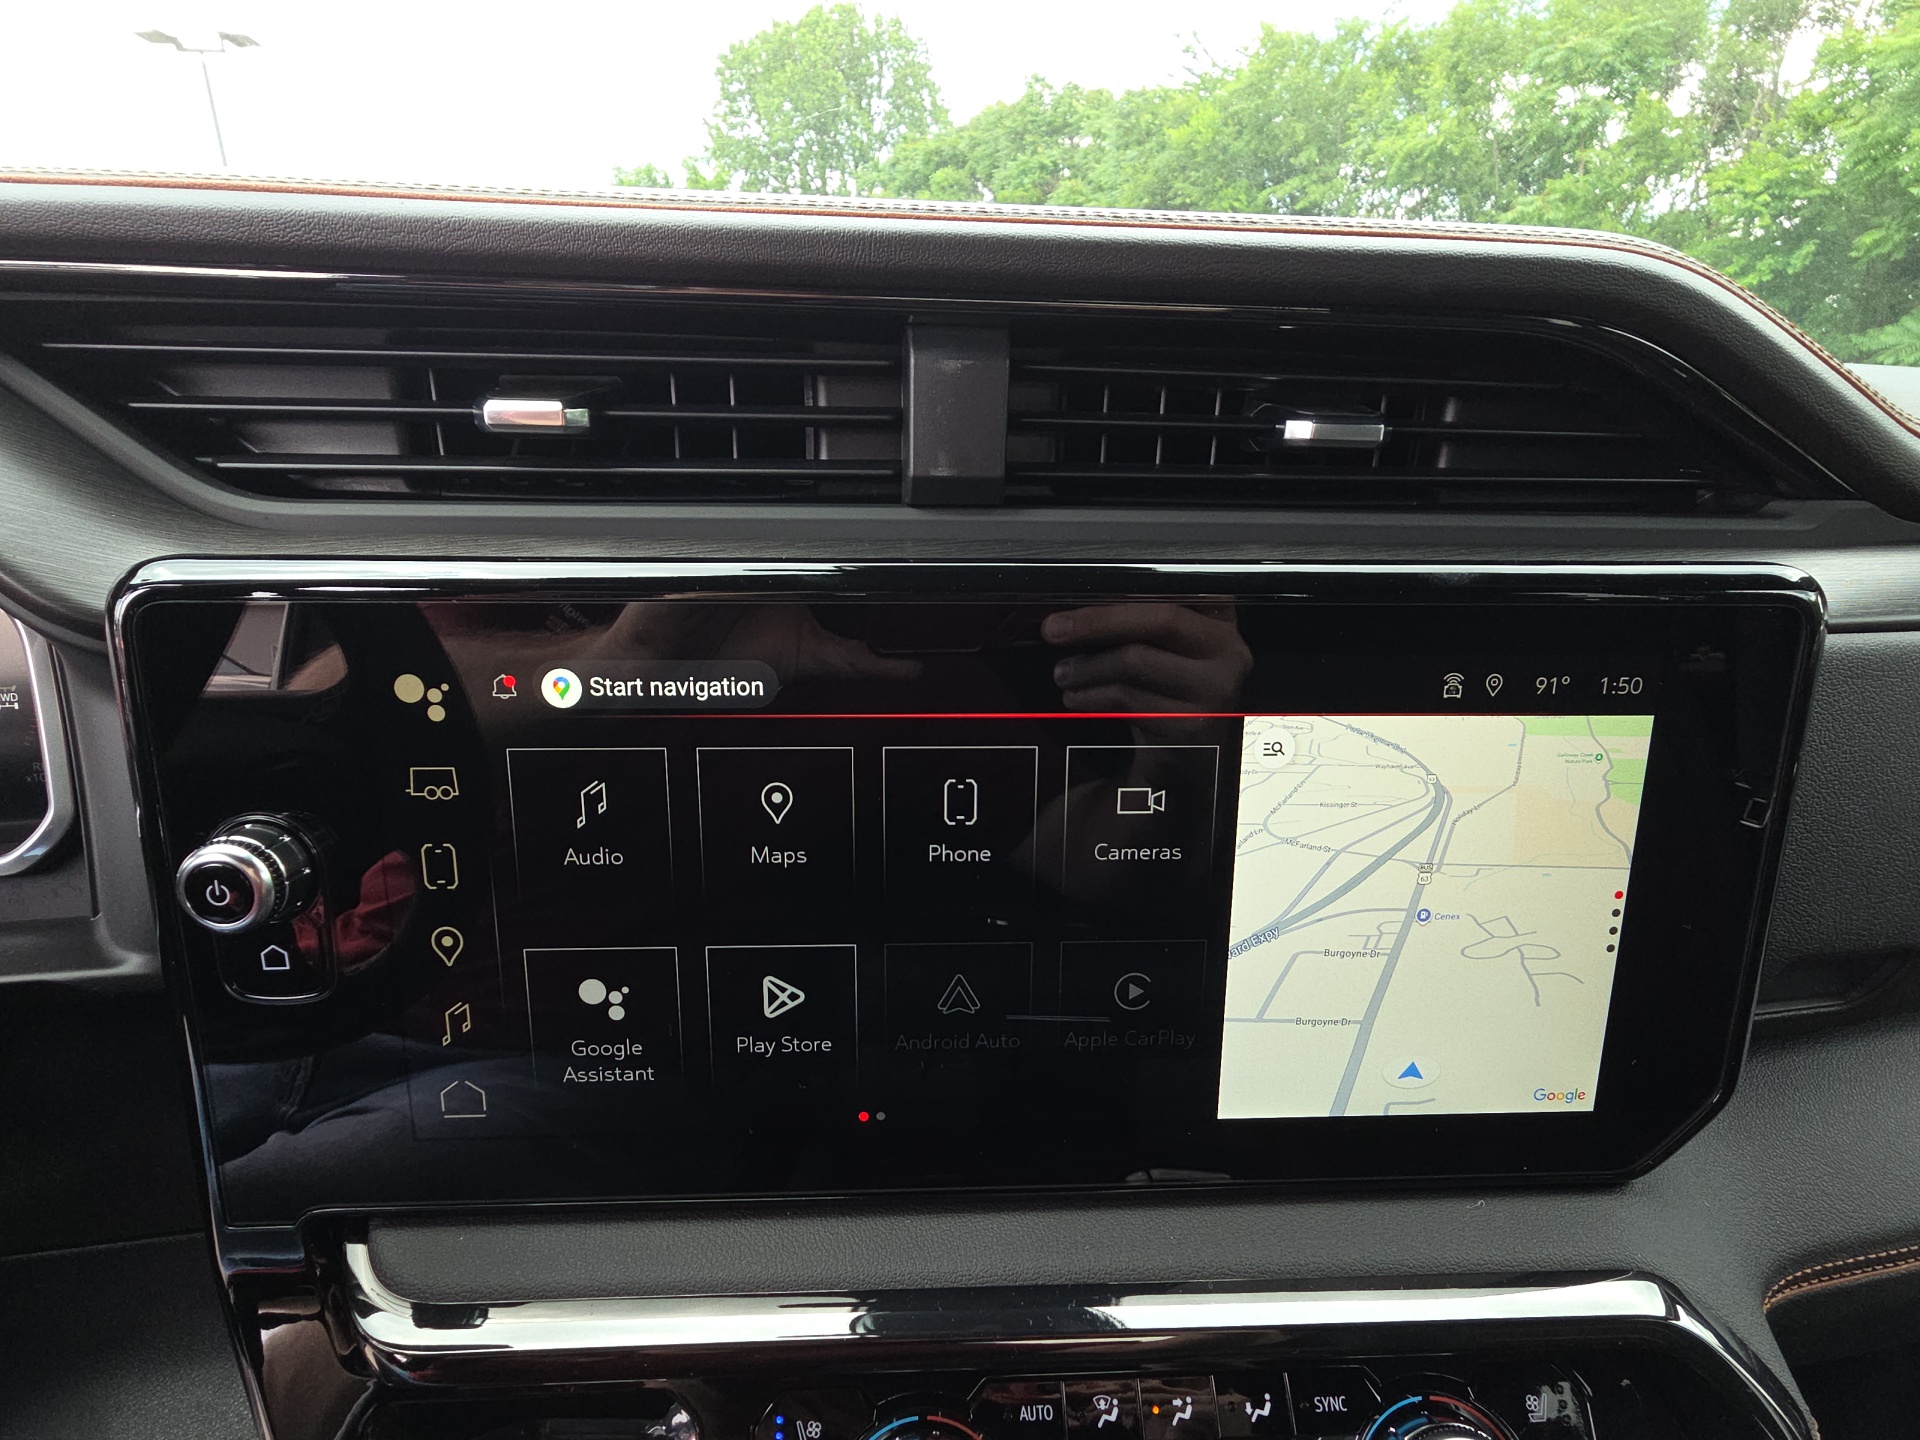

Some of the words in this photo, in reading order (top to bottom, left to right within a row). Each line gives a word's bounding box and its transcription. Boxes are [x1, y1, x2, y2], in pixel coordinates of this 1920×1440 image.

[589, 676, 643, 697] Start
[650, 676, 764, 701] navigation
[1535, 675, 1570, 695] 91°
[1600, 676, 1643, 695] 1:50
[0, 693, 19, 702] WD
[1270, 786, 1298, 815] McFarland
[1296, 780, 1306, 791] Ln
[1320, 801, 1349, 809] Kissinger
[1253, 828, 1263, 836] Ln
[928, 844, 991, 863] Phone
[1094, 843, 1182, 861] Cameras
[1285, 837, 1322, 852] McFarland
[1322, 845, 1331, 853] St
[564, 846, 624, 866] Audio
[751, 846, 807, 868] Maps
[1434, 912, 1460, 920] Cenex
[1251, 926, 1279, 947] Expy
[1323, 949, 1368, 959] Burgoyne
[1370, 949, 1381, 958] Dr
[1295, 1017, 1339, 1027] Burgoyne
[1341, 1017, 1352, 1026] Dr
[571, 1038, 643, 1061] Google
[736, 1036, 776, 1057] Play
[781, 1036, 832, 1053] Store
[895, 1031, 970, 1050] Android
[975, 1031, 1021, 1049] Auto
[1064, 1031, 1119, 1052] Apple
[1124, 1029, 1197, 1050] CarPlay
[563, 1066, 655, 1083] Assistant
[1533, 1088, 1586, 1104] Google
[1019, 1403, 1054, 1422] AUTO
[1313, 1396, 1348, 1413] SYNC
